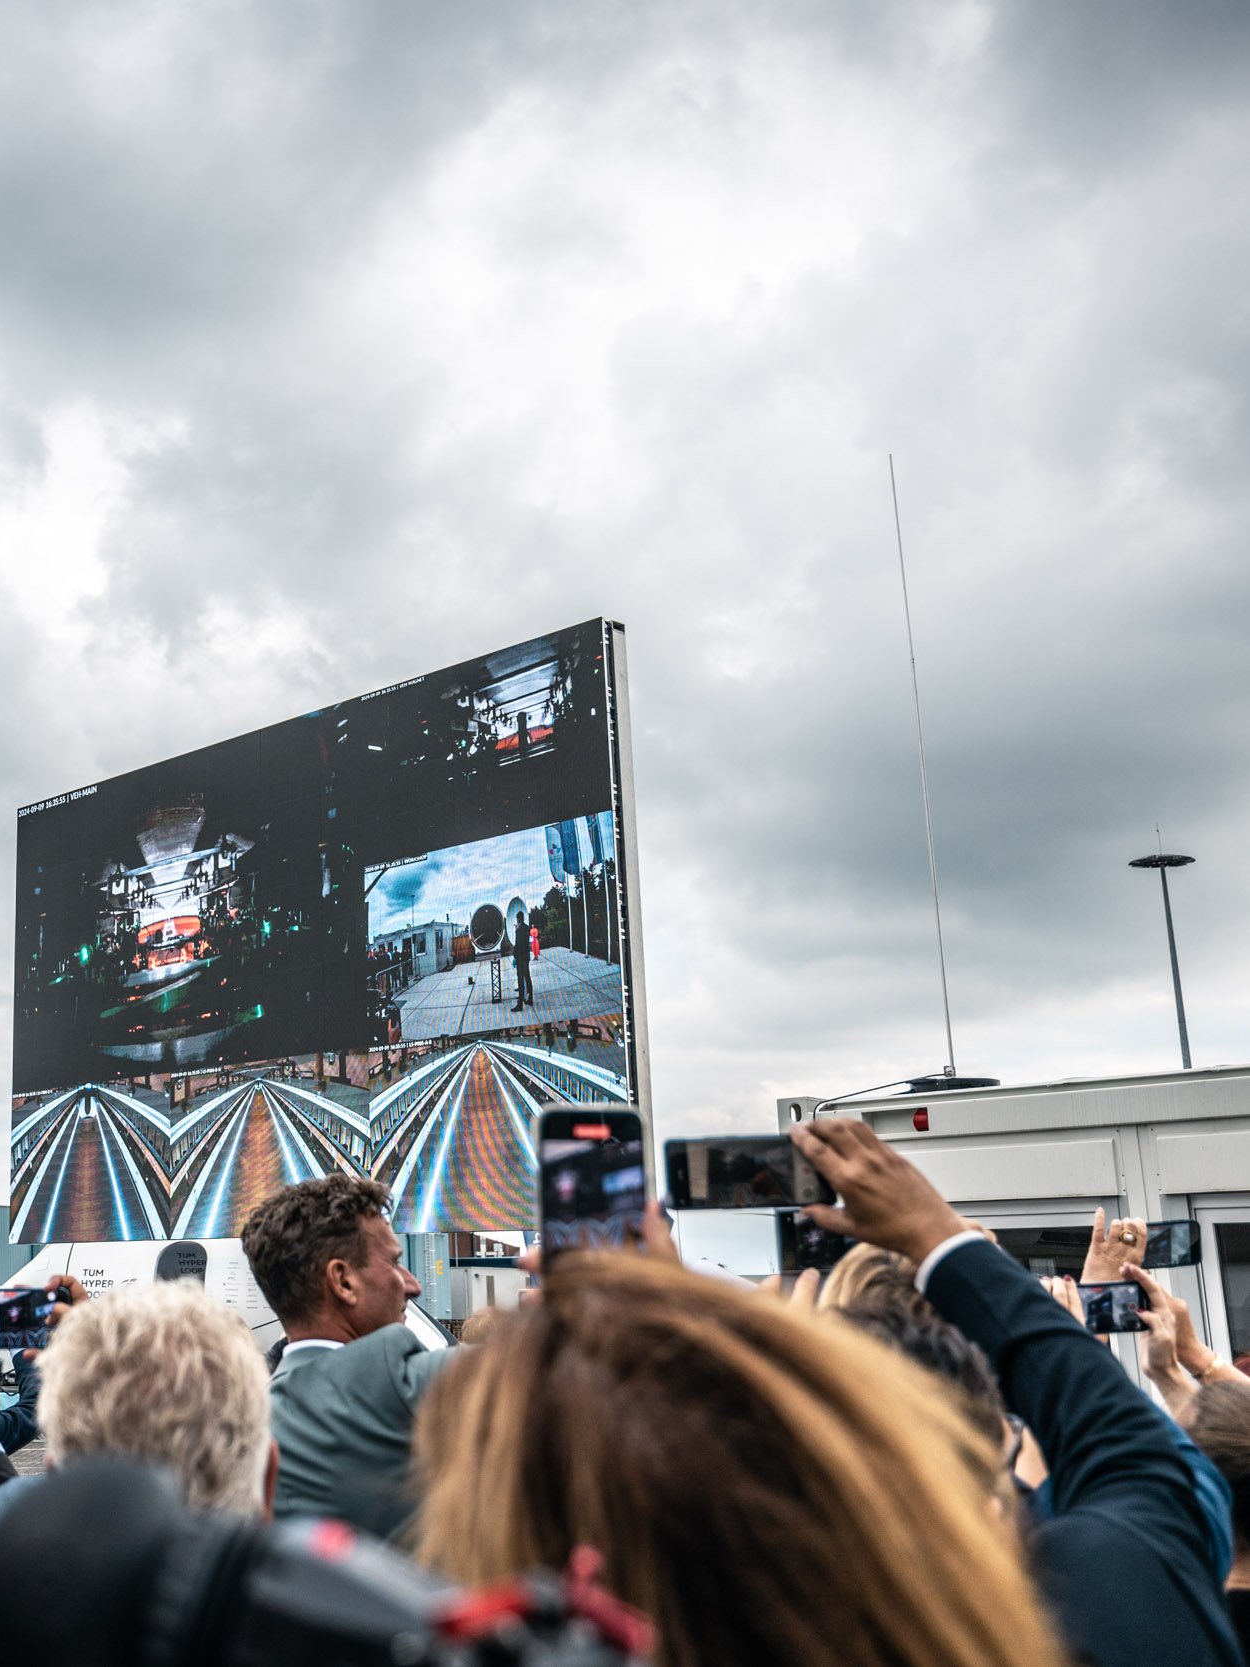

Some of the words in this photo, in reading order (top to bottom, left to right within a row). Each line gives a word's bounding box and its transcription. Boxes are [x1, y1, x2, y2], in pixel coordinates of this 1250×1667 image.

[18, 802, 44, 818] 2024-09-09
[45, 795, 66, 809] 16:35:55
[70, 785, 98, 800] VEH-MAIN
[83, 1268, 104, 1277] TUM
[81, 1279, 114, 1288] HYPER
